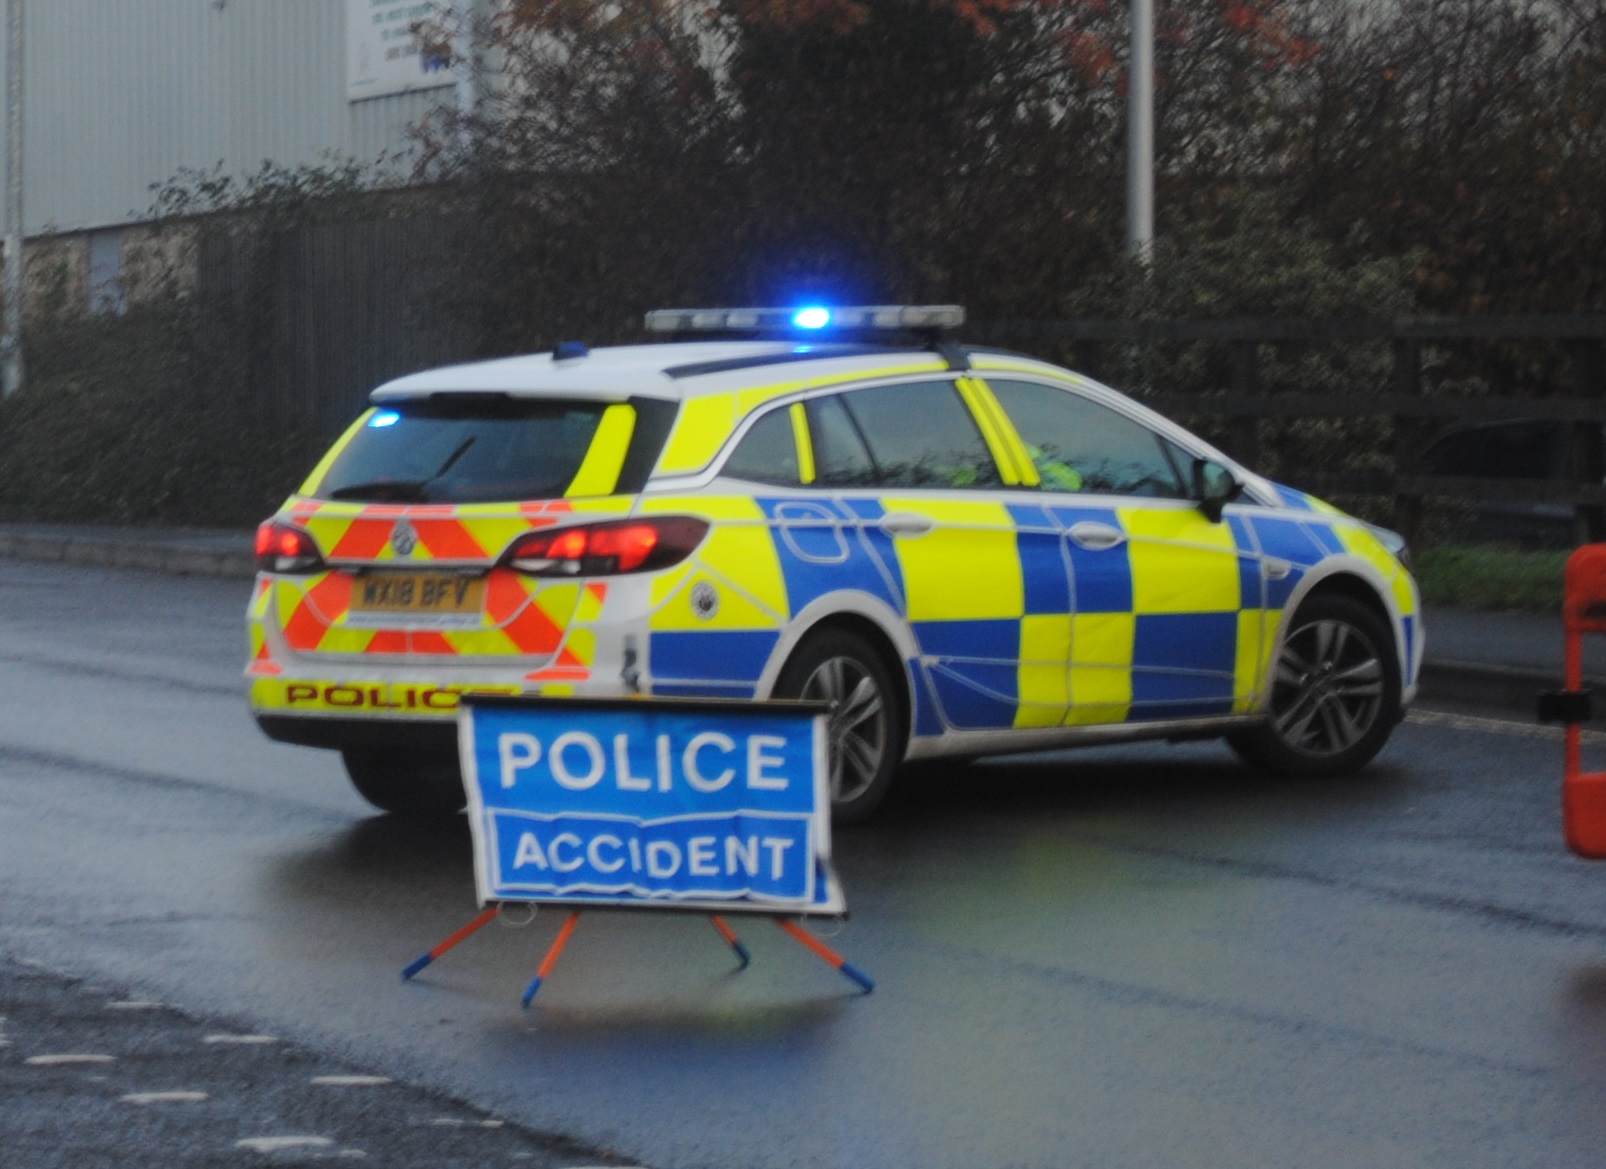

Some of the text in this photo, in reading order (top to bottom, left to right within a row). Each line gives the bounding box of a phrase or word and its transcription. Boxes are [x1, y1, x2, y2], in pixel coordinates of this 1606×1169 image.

[286, 684, 512, 709] POLIC
[498, 731, 790, 793] POLICE
[512, 831, 794, 880] ACCIDENT
